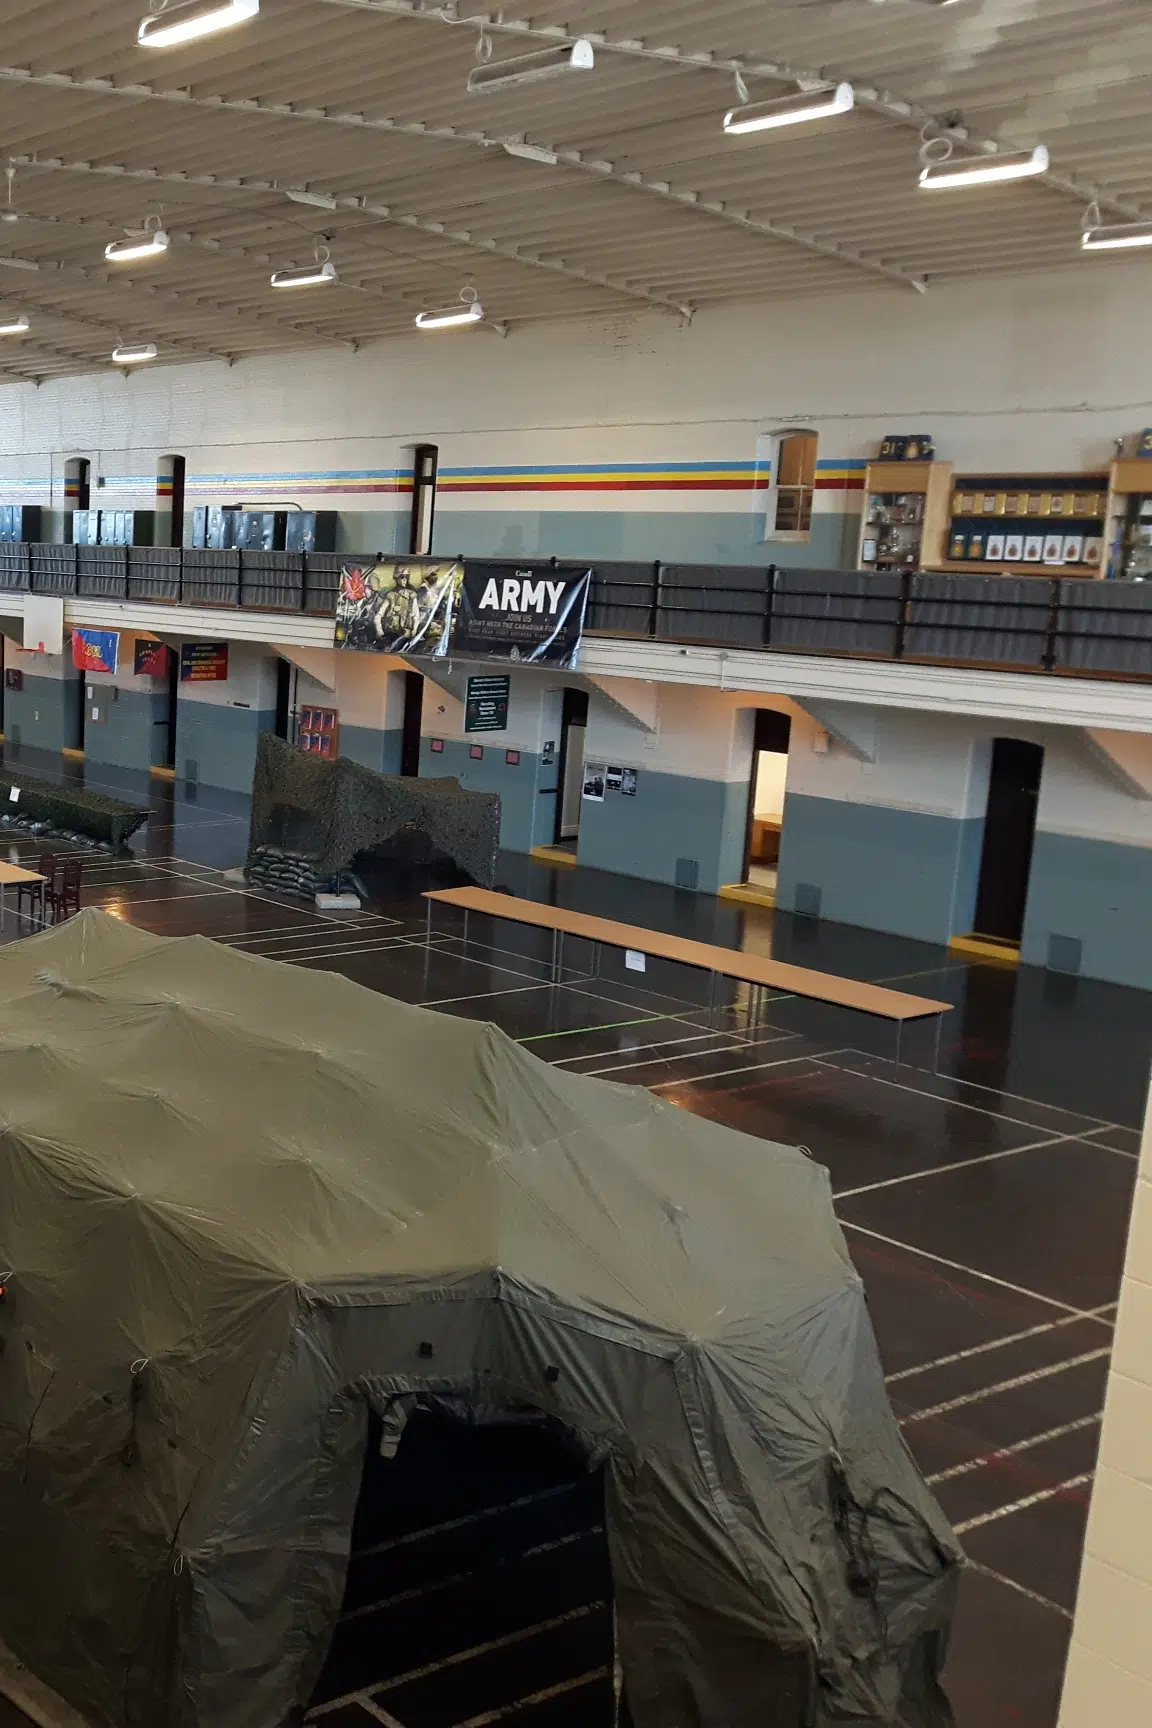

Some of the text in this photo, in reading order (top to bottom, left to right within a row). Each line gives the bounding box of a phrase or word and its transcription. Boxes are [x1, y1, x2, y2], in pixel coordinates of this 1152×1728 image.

[478, 578, 567, 614] ARMY
[522, 614, 532, 622] US
[514, 623, 544, 631] CANADIAN
